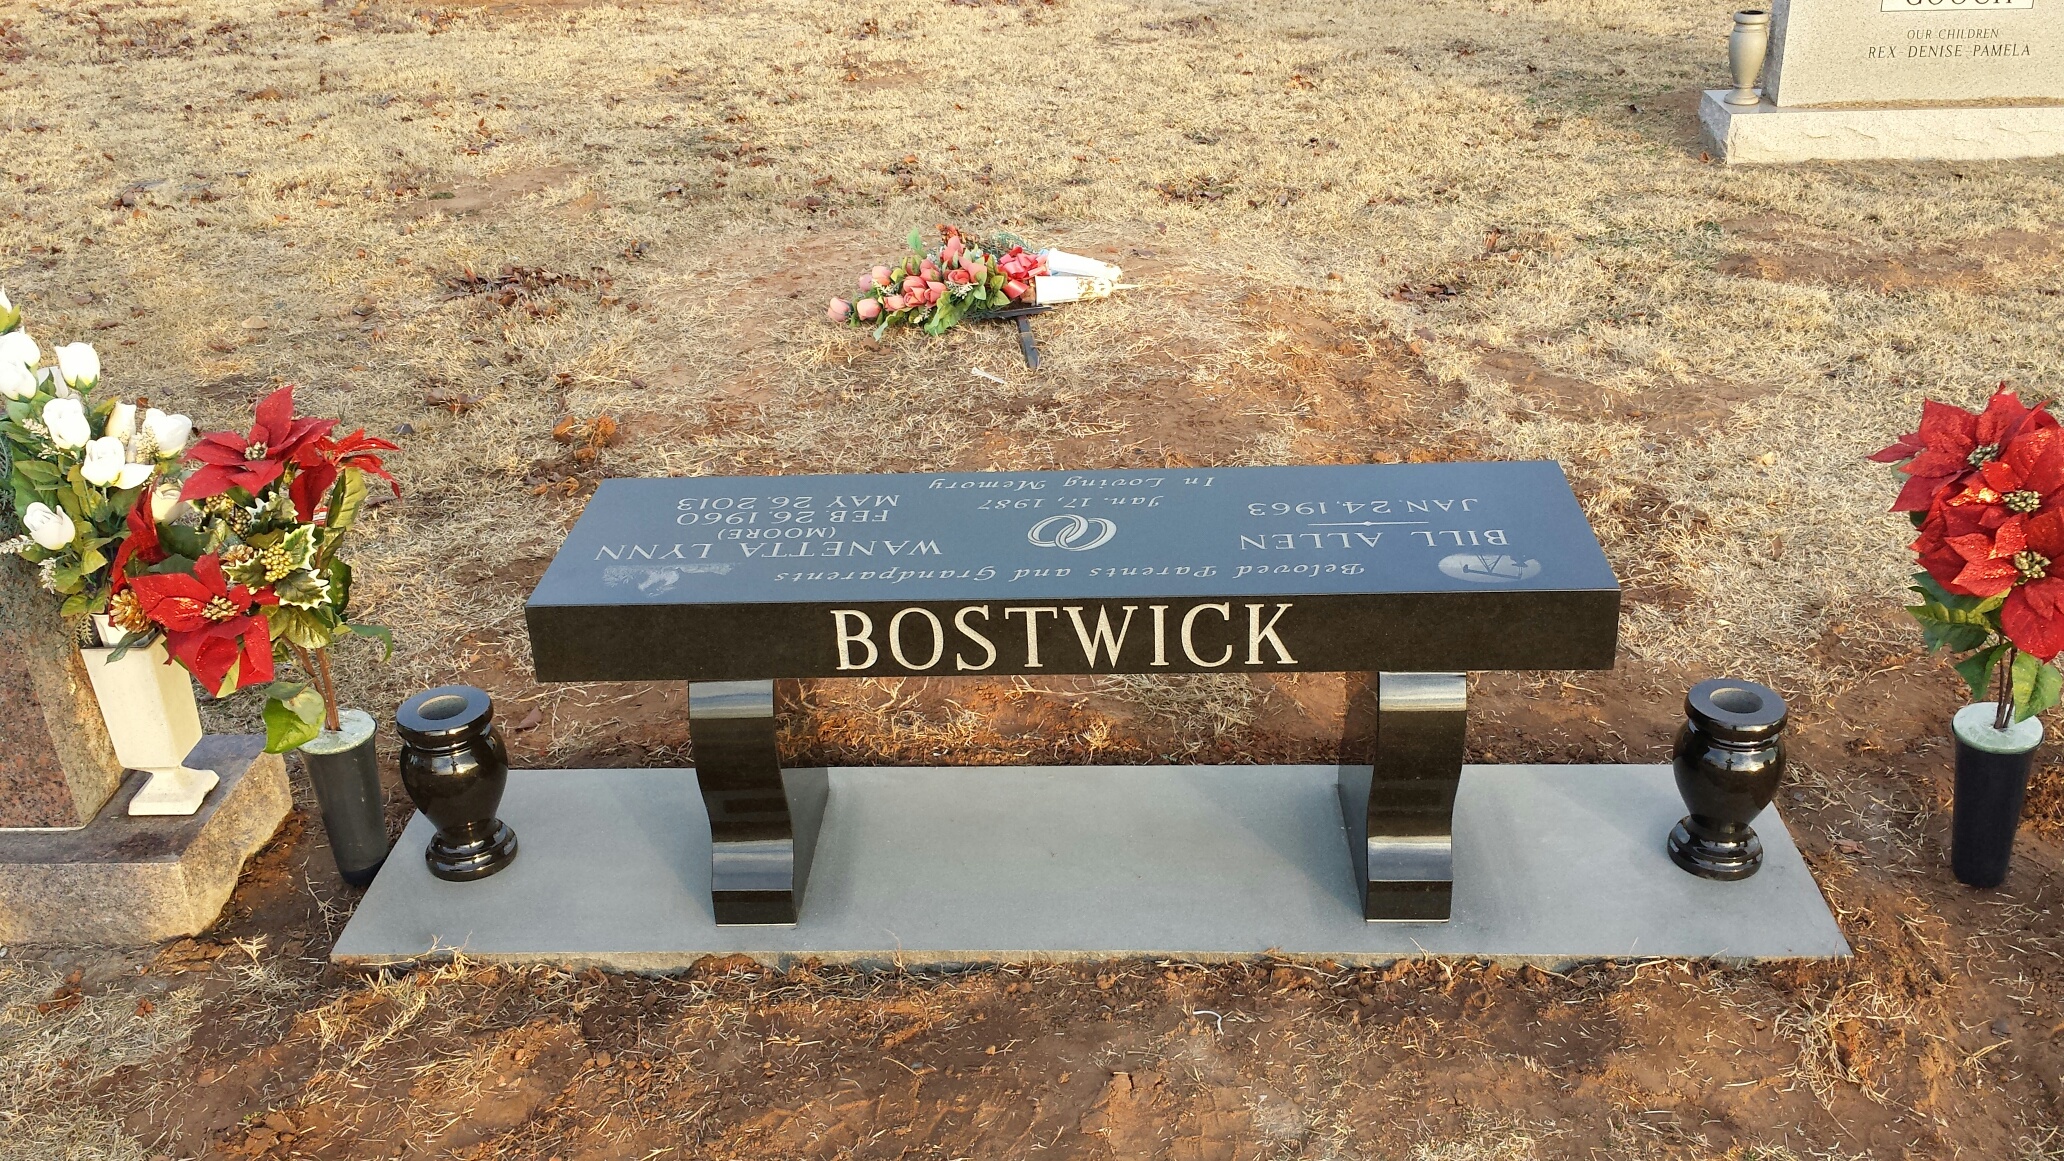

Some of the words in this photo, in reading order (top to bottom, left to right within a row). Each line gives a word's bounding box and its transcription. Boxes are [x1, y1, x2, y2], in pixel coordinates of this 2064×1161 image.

[1906, 29, 1932, 40] OUR
[1938, 28, 2000, 40] CHILDREN
[1868, 46, 1897, 59] REX
[1908, 45, 1963, 58] DENISE
[1973, 44, 2031, 57] PAMELA
[928, 478, 1046, 490] Memory
[1064, 476, 1165, 489] Loving
[1184, 477, 1216, 488] In
[676, 497, 757, 511] 2013
[826, 494, 900, 507] MAY
[976, 498, 1046, 510] 1987
[1104, 496, 1164, 508] Jan.
[1399, 498, 1478, 513] JAN.
[1248, 501, 1328, 516] 1963
[676, 511, 756, 525] 1960
[826, 509, 890, 523] FEB.
[717, 526, 837, 540] (MOORE)
[1410, 529, 1510, 546] BILL
[1239, 532, 1384, 550] ALLEN
[593, 542, 713, 561] LYNN
[739, 540, 943, 558] WANETTA
[774, 565, 997, 583] Grandparents
[1008, 568, 1071, 582] and
[1088, 565, 1217, 579] Parents
[1232, 562, 1365, 579] Beloved
[830, 602, 1299, 671] BOSTWICK
